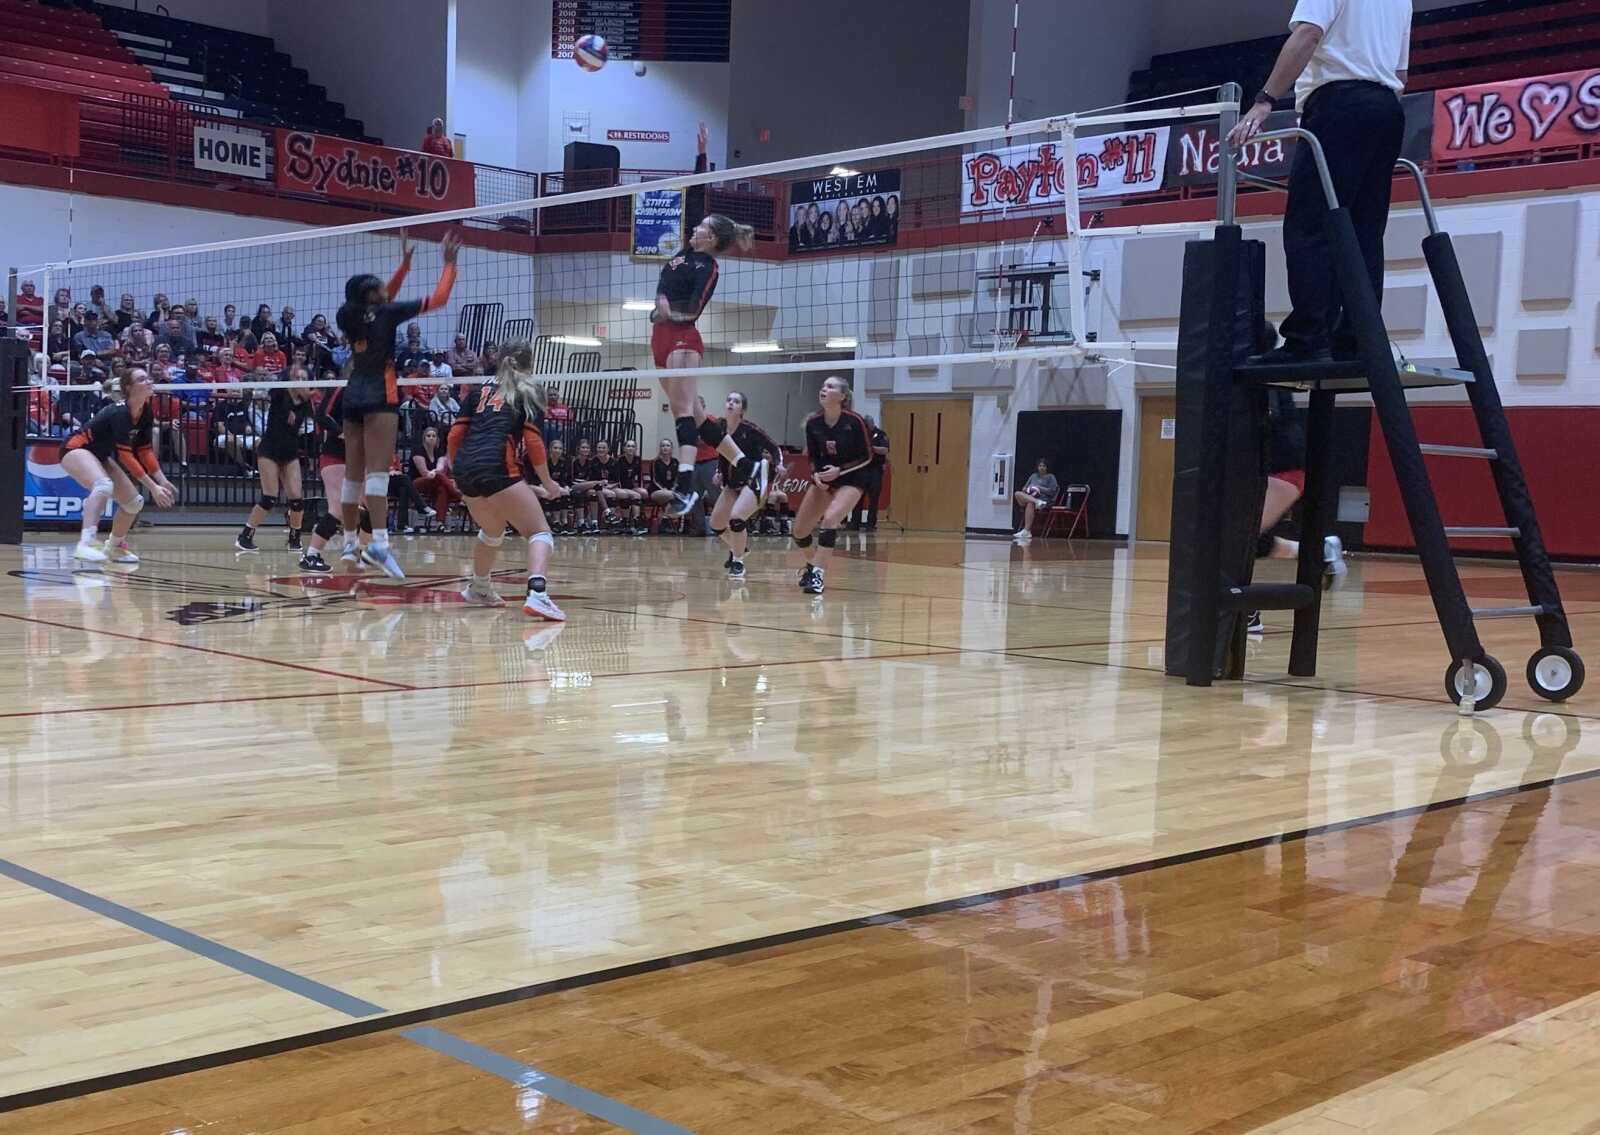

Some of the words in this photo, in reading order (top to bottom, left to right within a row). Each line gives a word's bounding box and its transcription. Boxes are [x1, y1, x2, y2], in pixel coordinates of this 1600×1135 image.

[623, 131, 669, 140] RESTROOMS
[1443, 92, 1516, 150] We
[199, 137, 261, 168] HOME
[285, 131, 398, 194] Sydnie
[396, 152, 449, 200] #10
[1099, 132, 1156, 184] #11
[24, 495, 113, 517] PEPI
